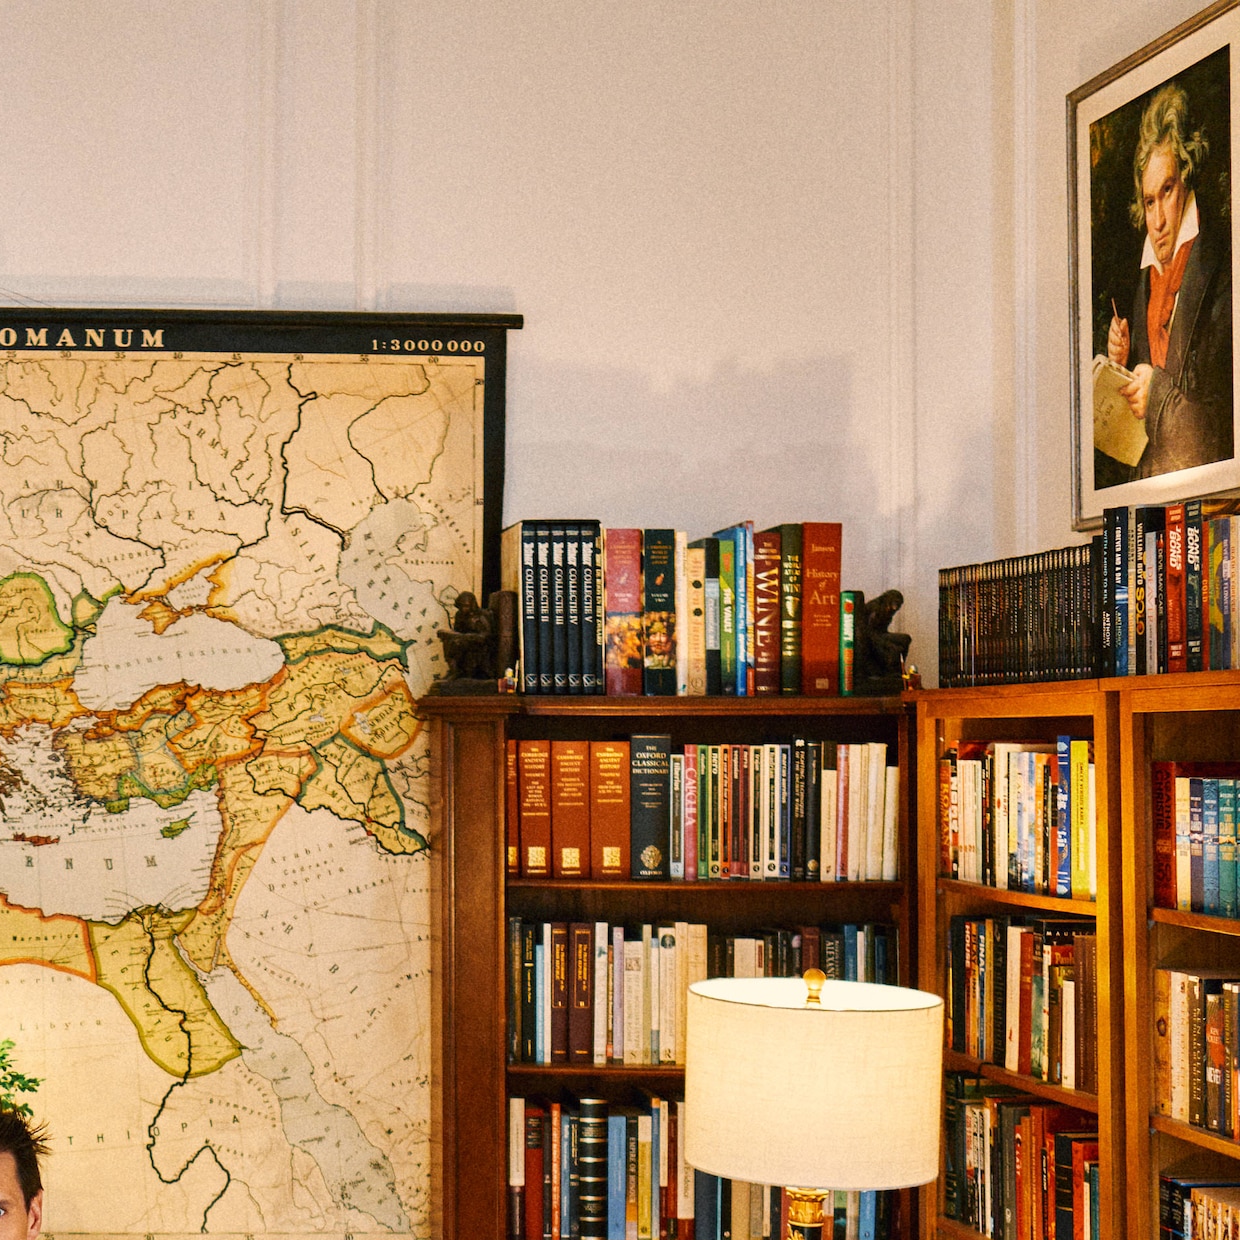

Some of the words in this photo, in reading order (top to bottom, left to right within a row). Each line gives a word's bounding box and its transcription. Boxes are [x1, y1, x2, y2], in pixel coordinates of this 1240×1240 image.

[60, 351, 71, 359] 30
[114, 351, 125, 360] 35
[172, 352, 183, 360] 40
[371, 338, 486, 353] 1:3000000
[1169, 530, 1177, 568] BOND
[1187, 527, 1195, 565] BOND
[806, 568, 839, 583] History
[818, 579, 827, 590] of
[1102, 577, 1108, 587] TO
[525, 568, 534, 615] COLLECTIE
[540, 568, 549, 615] COLLECTIE
[555, 568, 564, 615] COLLECTIE
[569, 568, 578, 615] COLLECTIE
[584, 568, 593, 615] COLLECTIE
[723, 587, 733, 604] THE
[809, 590, 837, 605] Art
[756, 566, 779, 646] WINE
[1135, 586, 1145, 635] SOLO
[555, 616, 564, 625] III
[569, 616, 578, 626] IV
[584, 616, 593, 624] V
[723, 606, 733, 634] VAULT
[711, 752, 719, 775] nero
[1155, 770, 1164, 830] CHRISTIE
[1164, 770, 1172, 830] AGATHA
[942, 783, 950, 847] ROMAN
[11, 932, 80, 943] Marmarica
[629, 1136, 637, 1162] EMPIRE
